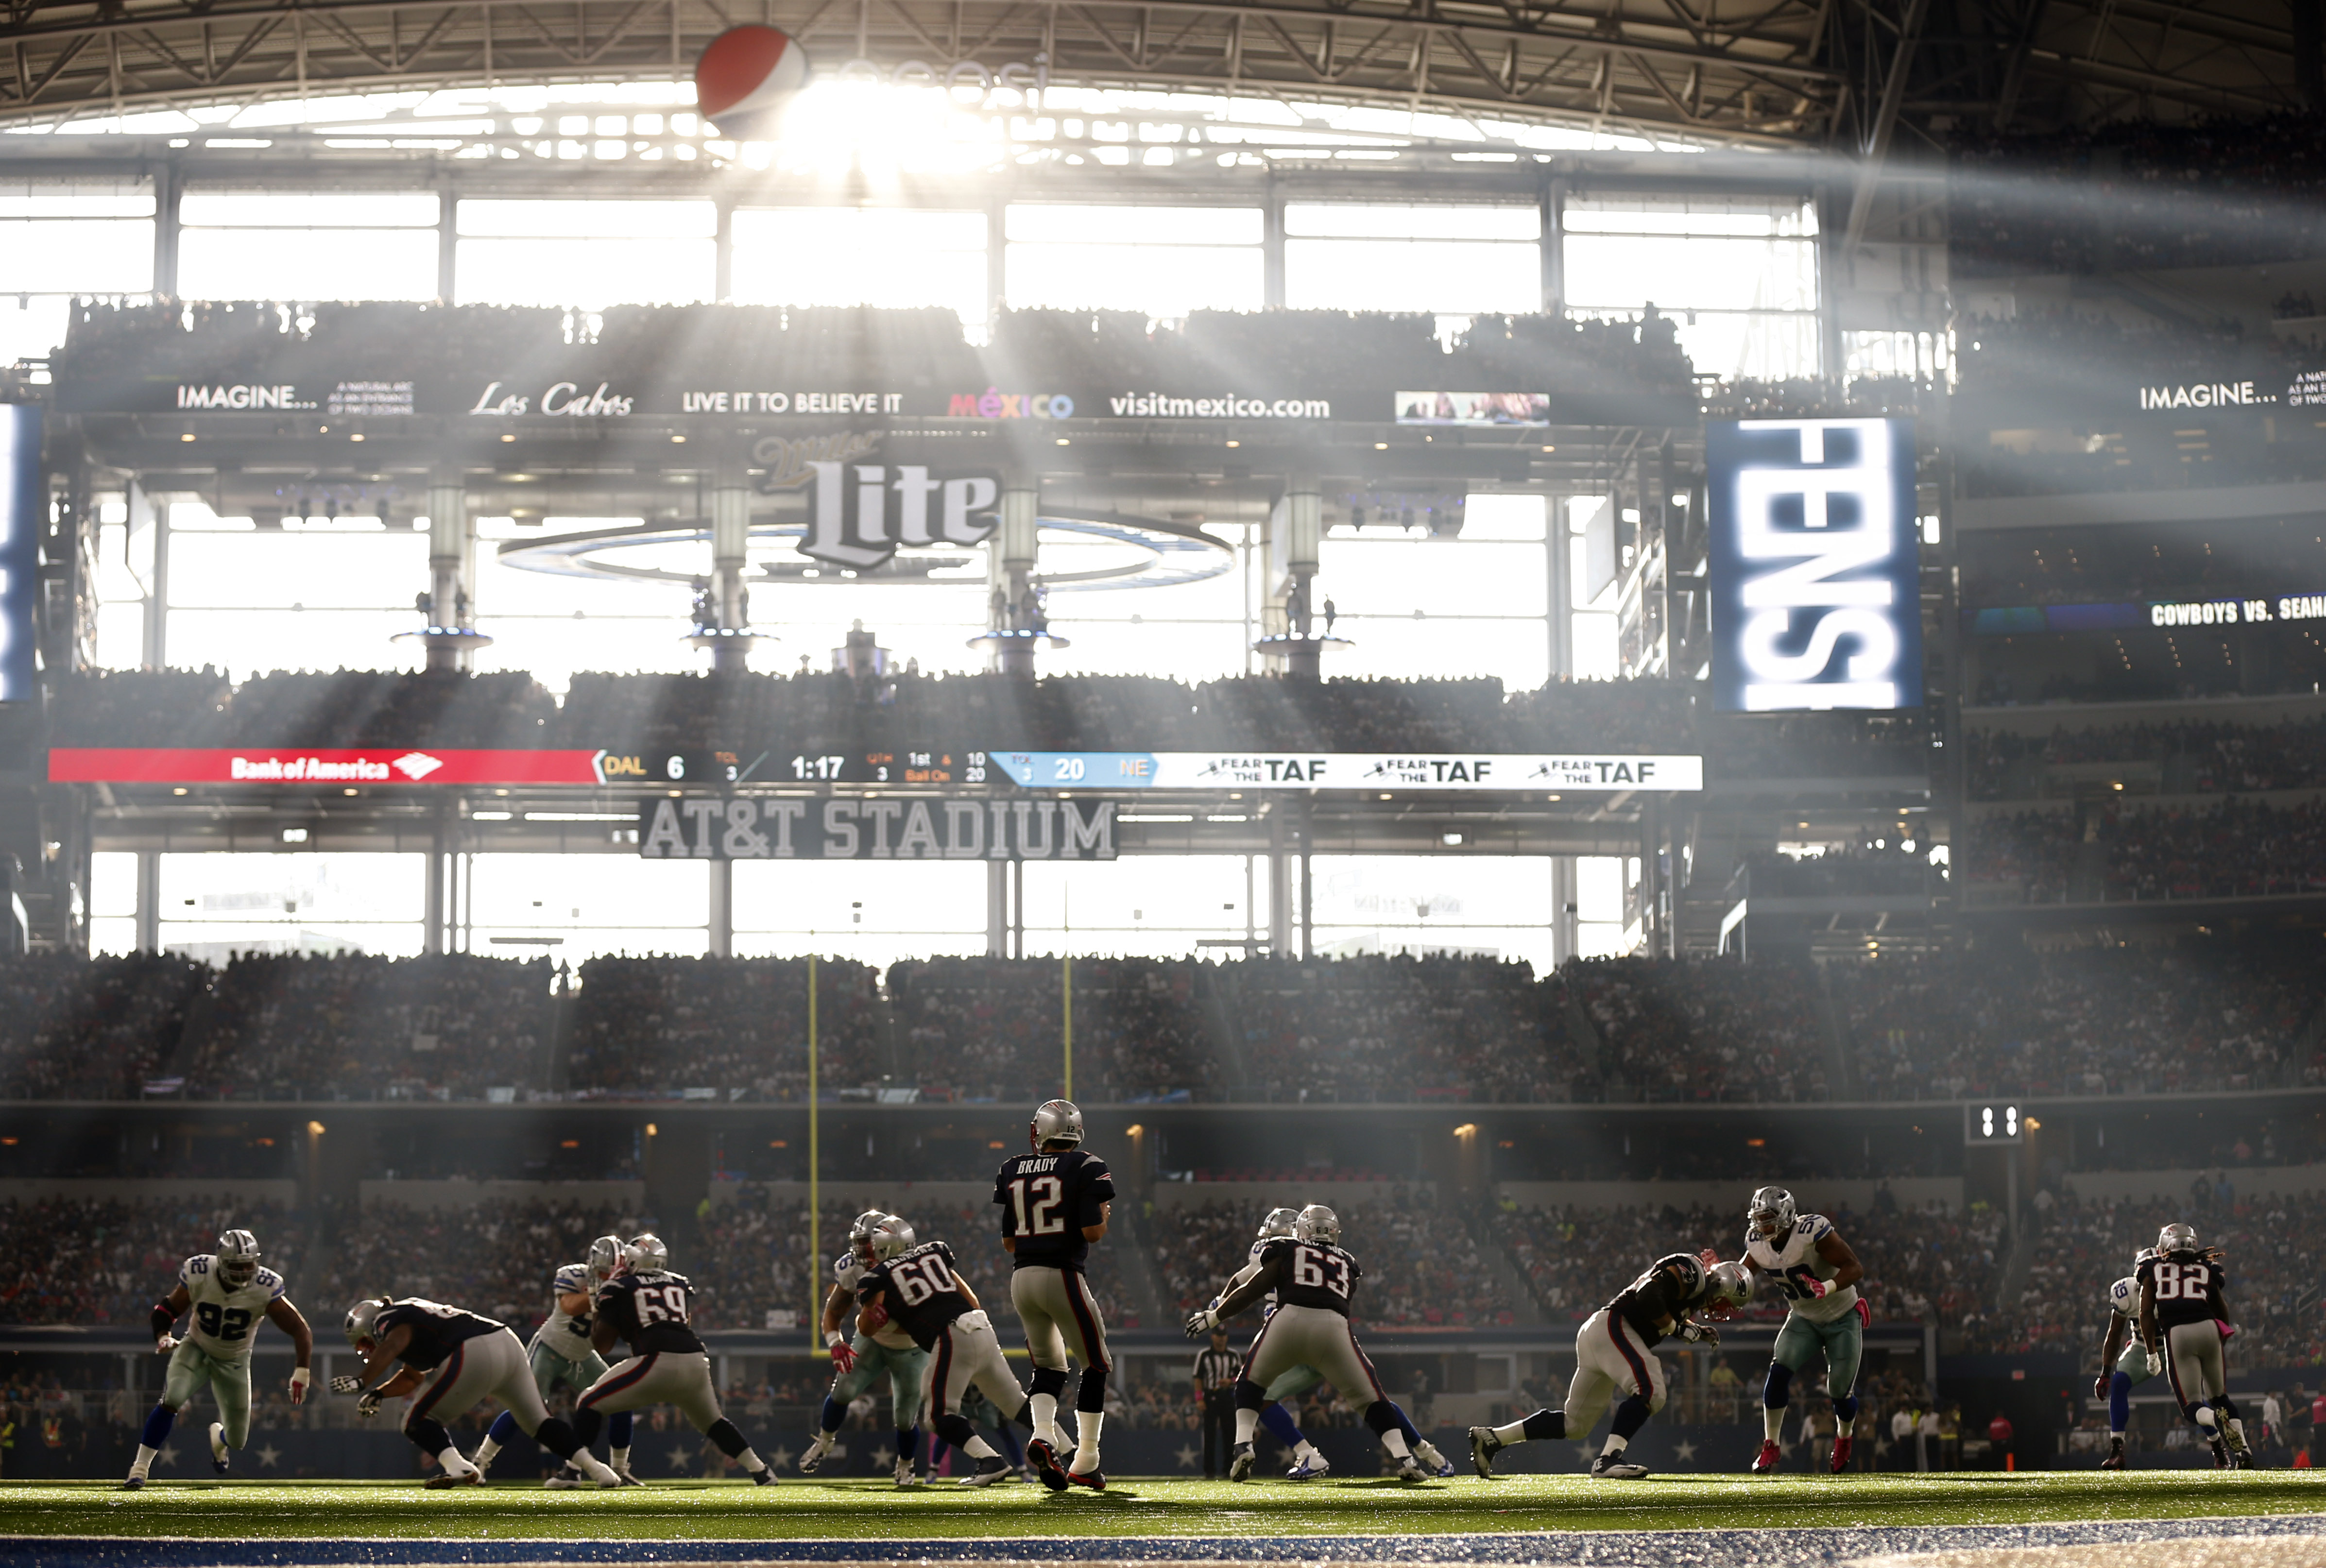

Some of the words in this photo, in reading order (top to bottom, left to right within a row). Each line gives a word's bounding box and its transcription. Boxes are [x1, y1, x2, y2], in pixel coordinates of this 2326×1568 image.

[2296, 373, 2305, 383] A
[2303, 383, 2319, 394] AN
[178, 385, 318, 409] IMAGINE...
[469, 382, 530, 416] Los
[541, 382, 634, 417] Cabos
[683, 392, 729, 413] LIVE
[734, 392, 753, 413] IT
[756, 392, 789, 413] TO
[794, 392, 878, 413] BELIEVE
[883, 393, 903, 413] IT
[1110, 392, 1330, 418] visitmexico.com
[2140, 381, 2277, 410] IMAGINE...
[2289, 395, 2304, 407] OF
[803, 461, 997, 567] Lite
[2151, 601, 2238, 627] COWBOYS
[2242, 599, 2274, 623] VS.
[231, 757, 283, 780] Bank
[283, 757, 307, 779] of
[306, 758, 389, 780] America
[604, 755, 647, 775] DAL
[667, 755, 684, 779] 6
[791, 755, 844, 779] 1:17
[908, 751, 931, 766] 1st
[967, 751, 986, 767] 10
[1054, 758, 1085, 780] 20
[1121, 759, 1149, 776] NE
[1221, 758, 1262, 769] FEAR
[1387, 759, 1427, 770] FEAR
[1552, 760, 1591, 771] FEAR
[726, 766, 738, 781] 3
[877, 766, 888, 782] 3
[930, 769, 951, 782] On
[965, 767, 986, 782] 20
[1023, 767, 1033, 781] 3
[1233, 772, 1262, 782] THE
[1265, 760, 1327, 782] TAF
[1400, 773, 1427, 783] THE
[1430, 761, 1491, 783] TAF
[1564, 774, 1591, 784] THE
[1595, 762, 1656, 784] TAF
[641, 800, 805, 857] AT&T
[823, 801, 1116, 858] STADIUM
[1016, 1157, 1059, 1175] BRADY
[1008, 1175, 1065, 1238] 12
[891, 1253, 957, 1307] 60
[1295, 1245, 1350, 1300] 63
[2154, 1262, 2209, 1301] 82
[633, 1285, 688, 1329] 69
[197, 1301, 252, 1341] 92
